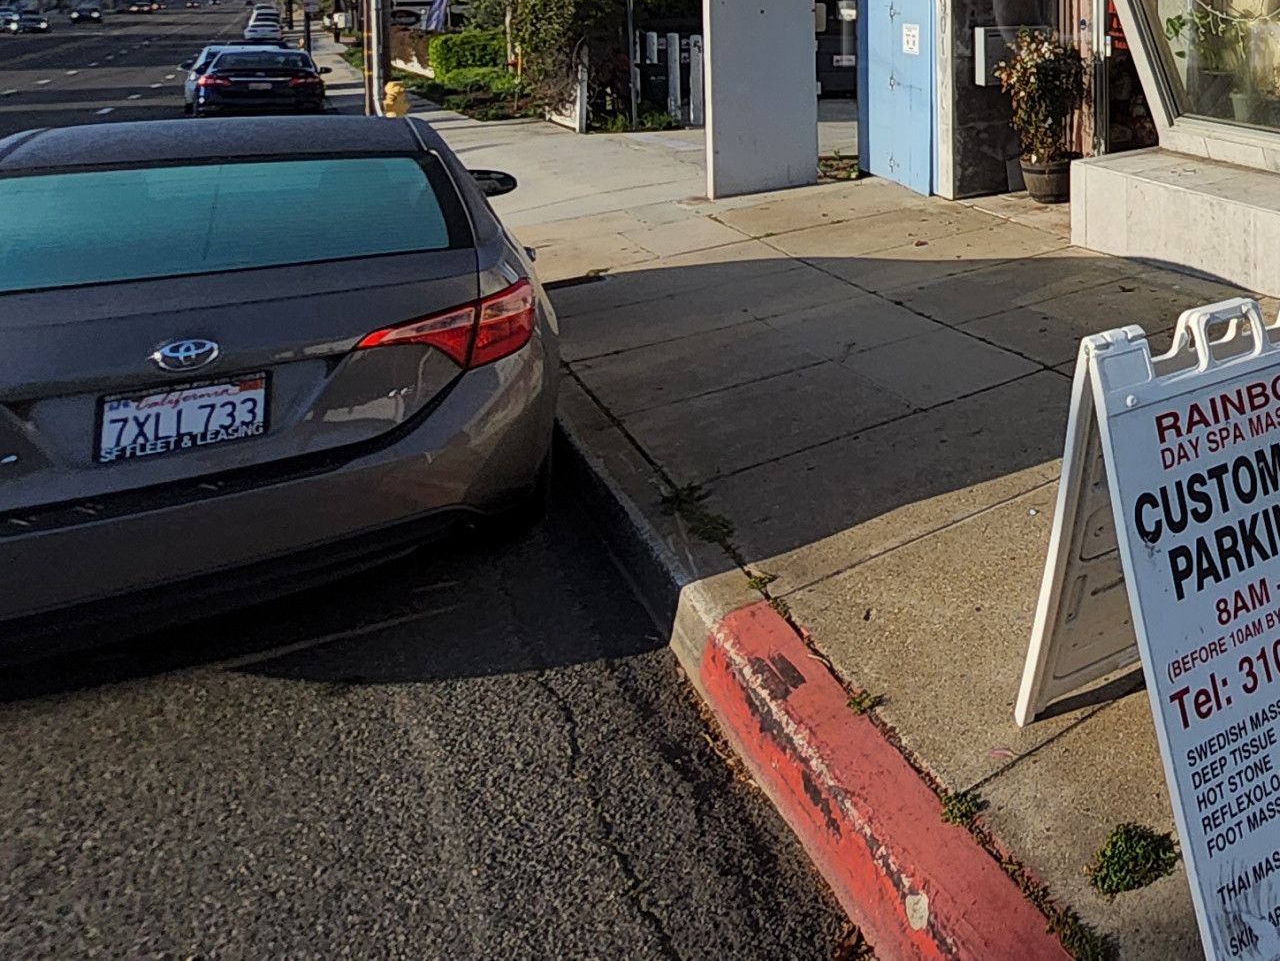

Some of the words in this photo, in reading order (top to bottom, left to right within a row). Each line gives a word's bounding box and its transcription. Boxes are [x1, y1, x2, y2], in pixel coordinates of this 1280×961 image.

[109, 398, 258, 447] 7XLL733
[135, 387, 239, 410] California
[101, 446, 121, 462] SF
[125, 436, 176, 458] FLEET
[181, 435, 192, 448] &
[197, 422, 264, 446] LEASING
[1160, 437, 1201, 471] DAY
[1206, 423, 1246, 455] SPA
[1215, 578, 1271, 625] 8AM
[1167, 637, 1228, 683] (BEFORE
[1229, 619, 1264, 648] 10AM
[1169, 672, 1233, 729] Tel:
[1186, 719, 1248, 767] SWEDISH
[1191, 756, 1227, 790] DEEP
[1230, 727, 1277, 766] TISSUE
[1196, 782, 1224, 813] HOT
[1228, 754, 1273, 793] STONE
[1207, 821, 1244, 859] FOOT
[1217, 870, 1251, 905] THAI
